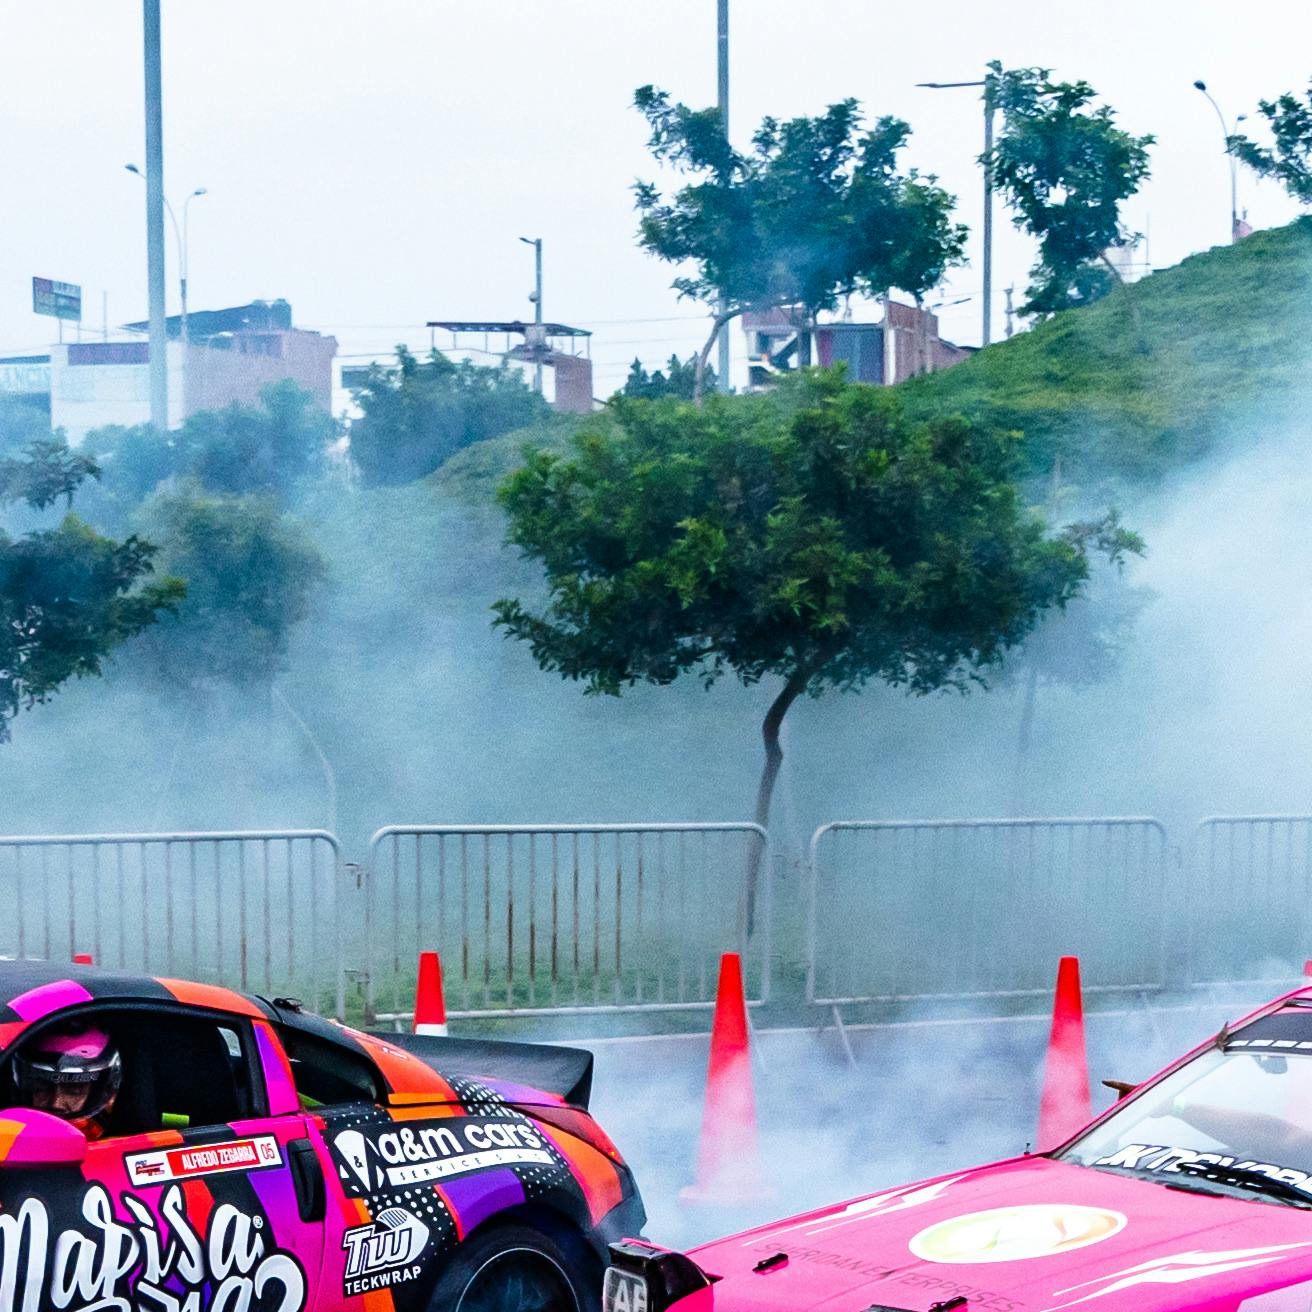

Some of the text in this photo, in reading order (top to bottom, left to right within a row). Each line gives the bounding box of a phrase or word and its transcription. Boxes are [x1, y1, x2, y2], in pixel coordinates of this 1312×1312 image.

[378, 1122, 542, 1164] a&m cars
[182, 1149, 219, 1170] ALFREDO
[400, 1156, 481, 1181] SERVICE
[345, 1265, 422, 1295] TECKWRAP
